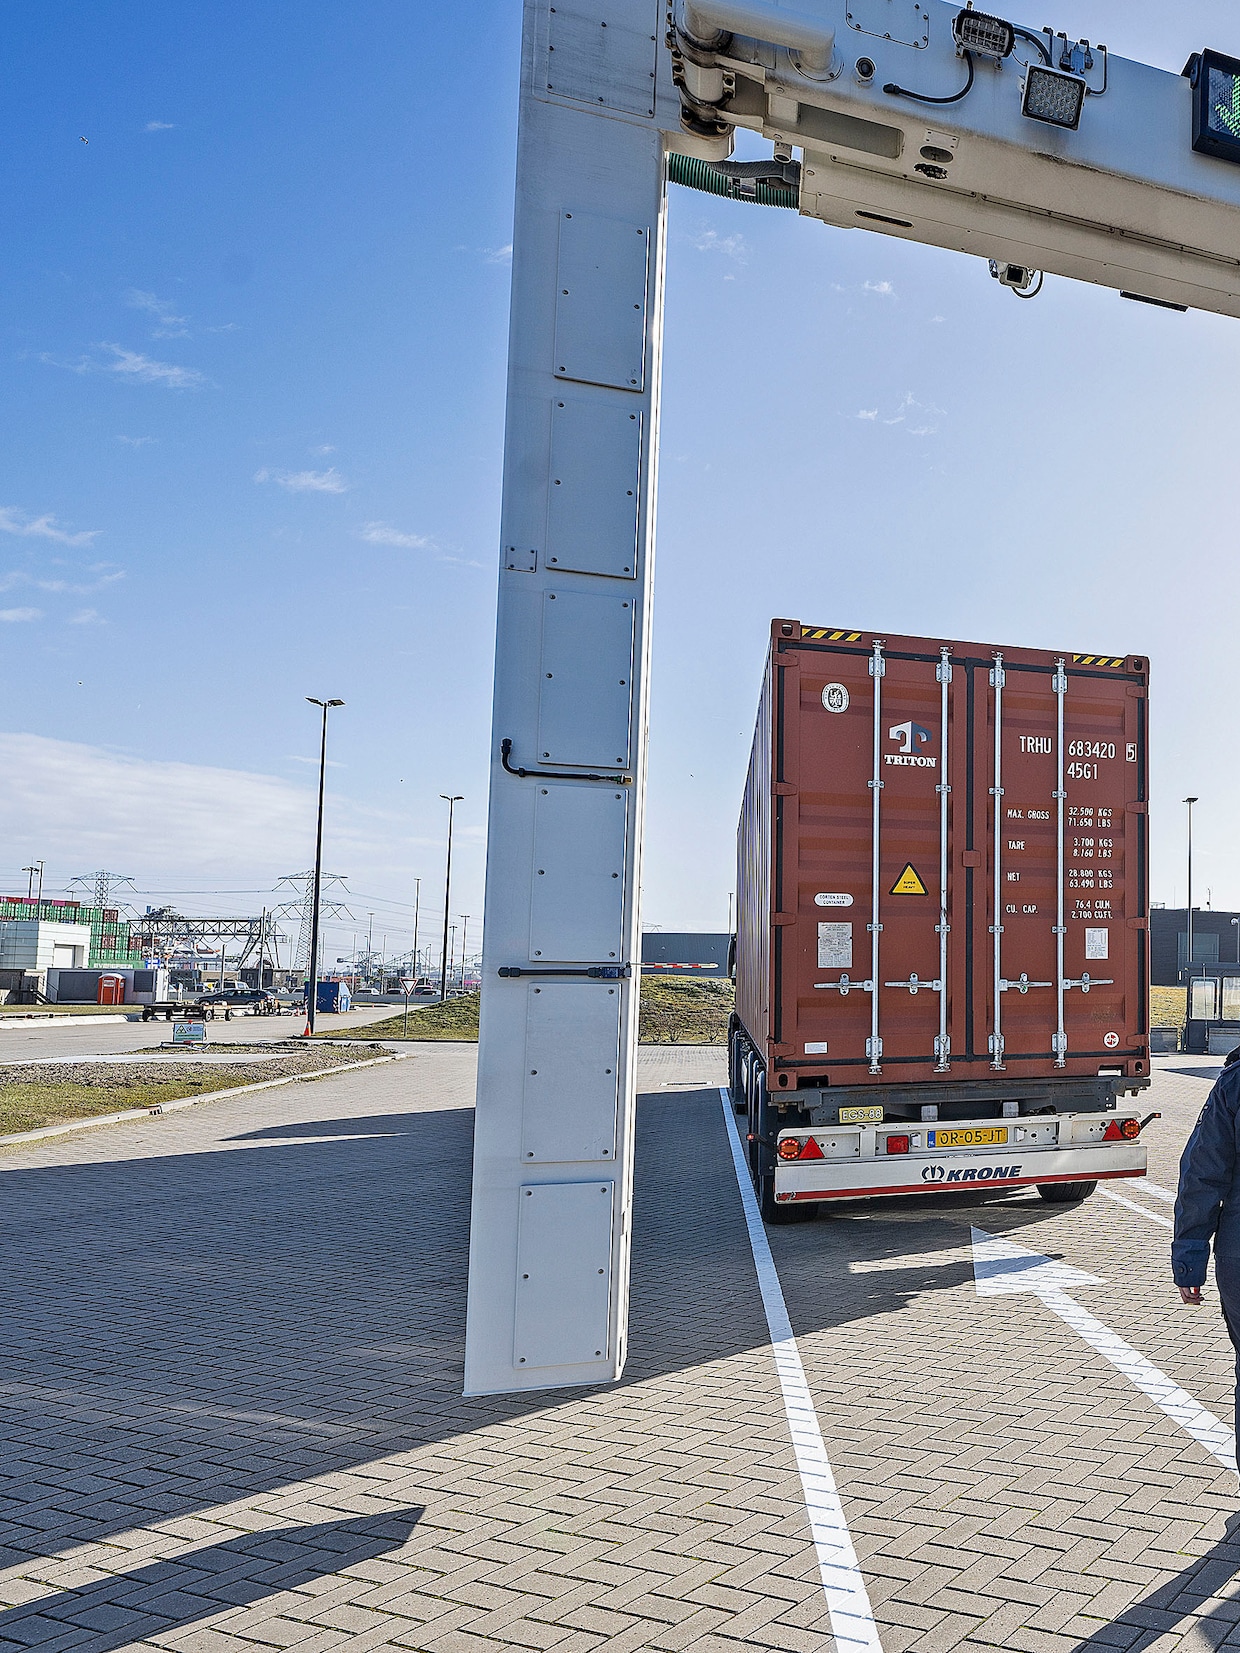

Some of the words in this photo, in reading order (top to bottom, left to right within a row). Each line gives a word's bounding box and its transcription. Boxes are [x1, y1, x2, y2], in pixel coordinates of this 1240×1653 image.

[1019, 735, 1052, 754] TRHU
[1068, 740, 1116, 759] 683420
[1126, 744, 1136, 761] 5
[884, 754, 937, 768] TRITON
[1067, 762, 1098, 780] 45G1
[1007, 809, 1024, 819] MAX.
[1028, 810, 1050, 820] GROSS
[1068, 806, 1094, 816] 32.500
[1098, 808, 1113, 817] KGS
[1067, 817, 1093, 827] 71.650
[1097, 819, 1112, 828] LBS
[1008, 840, 1026, 850] TARE
[1073, 838, 1094, 847] 3.700
[1099, 838, 1114, 847] KGS
[1072, 848, 1094, 858] 8.160
[1098, 849, 1113, 858] LBS
[1007, 872, 1020, 881] NET
[1068, 869, 1094, 878] 28.800
[1098, 869, 1113, 878] KGS
[1069, 879, 1095, 888] 63.490
[1098, 879, 1114, 888] LBS
[1005, 904, 1018, 913] CU.
[1022, 904, 1038, 914] CAP.
[1075, 899, 1091, 909] 76.4
[1071, 910, 1092, 919] 2.700
[842, 1108, 882, 1121] EGS-88
[940, 1129, 1003, 1145] OR-05-JT
[946, 1164, 1023, 1182] KRONE
